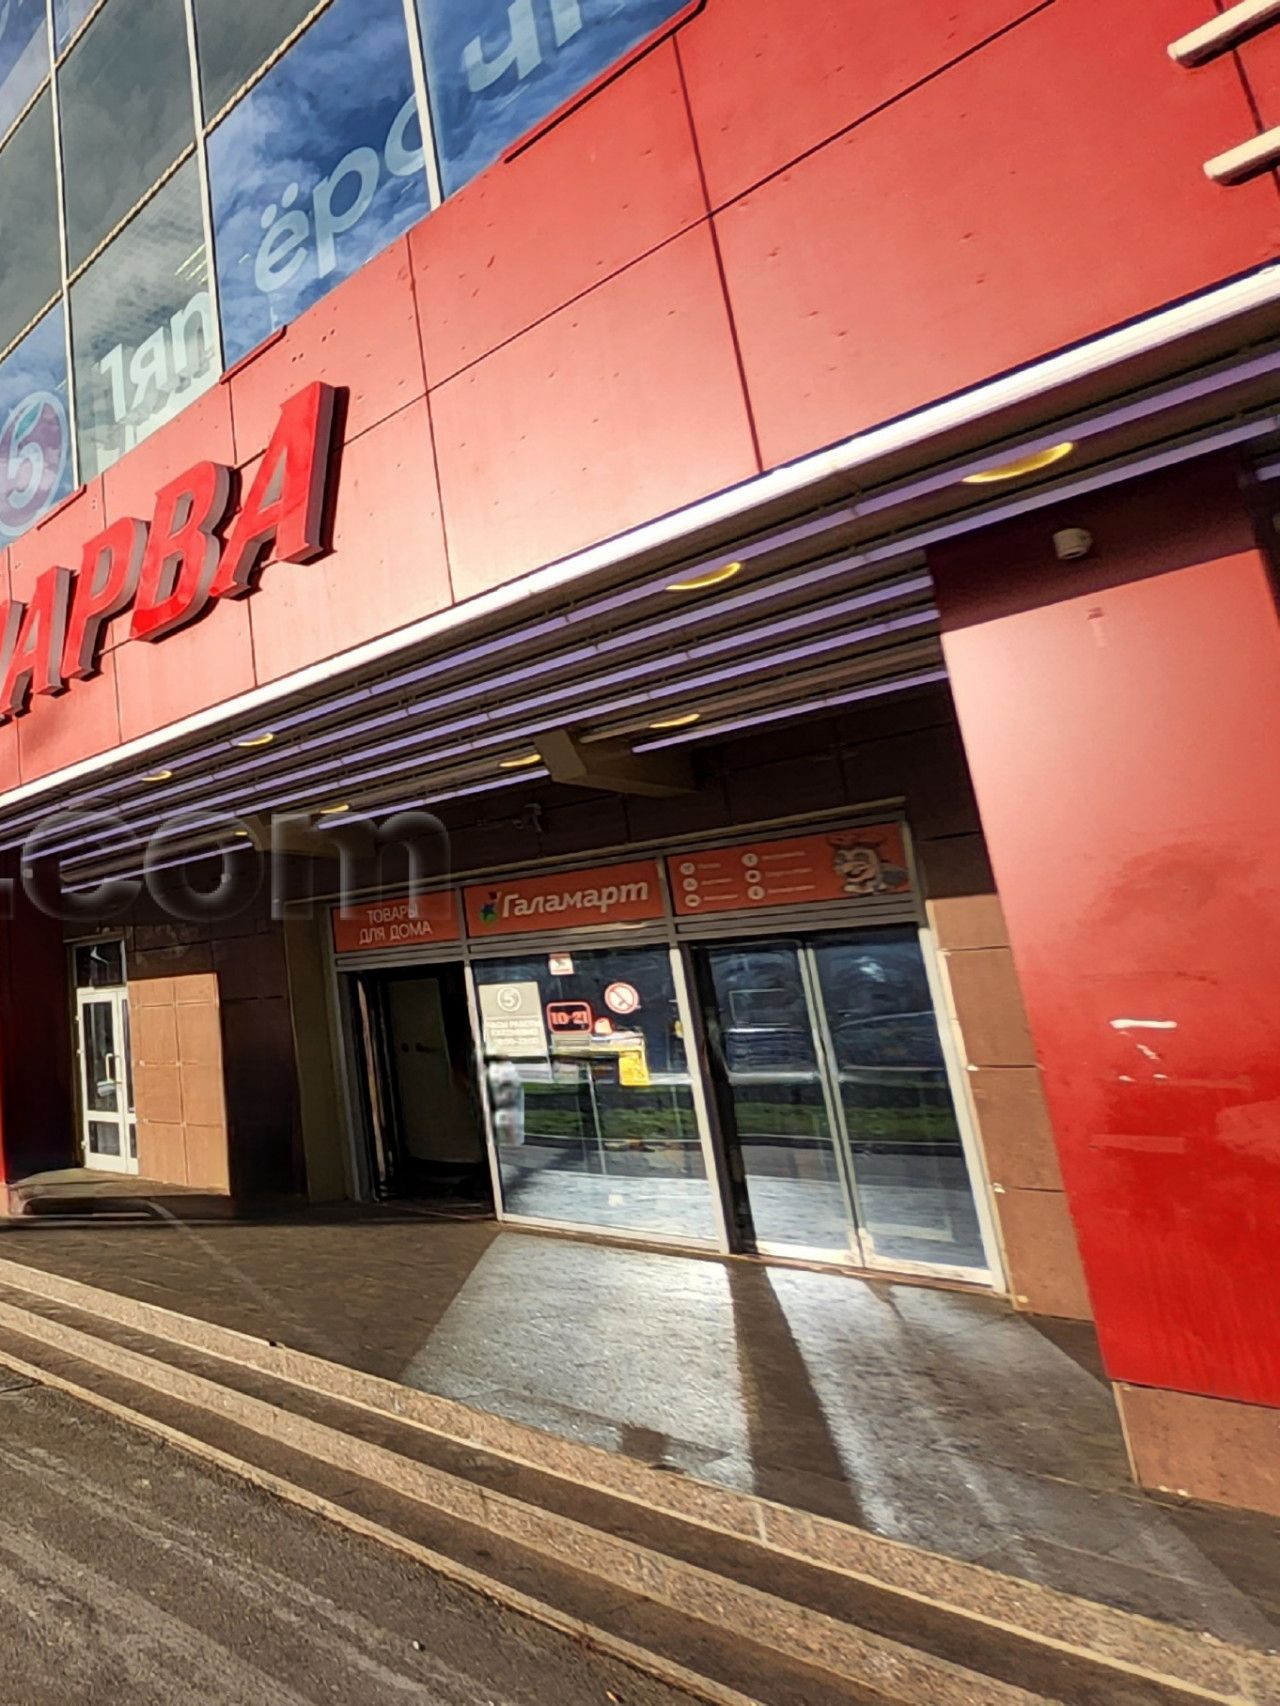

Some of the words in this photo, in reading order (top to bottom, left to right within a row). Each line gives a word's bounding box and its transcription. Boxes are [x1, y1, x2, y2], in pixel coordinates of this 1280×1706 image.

[501, 881, 648, 918] Галамарт
[366, 904, 418, 922] ТОВАРЫ
[358, 926, 386, 945] ДЛЯ
[390, 920, 433, 940] ДОМА
[550, 1011, 589, 1025] 10-21
